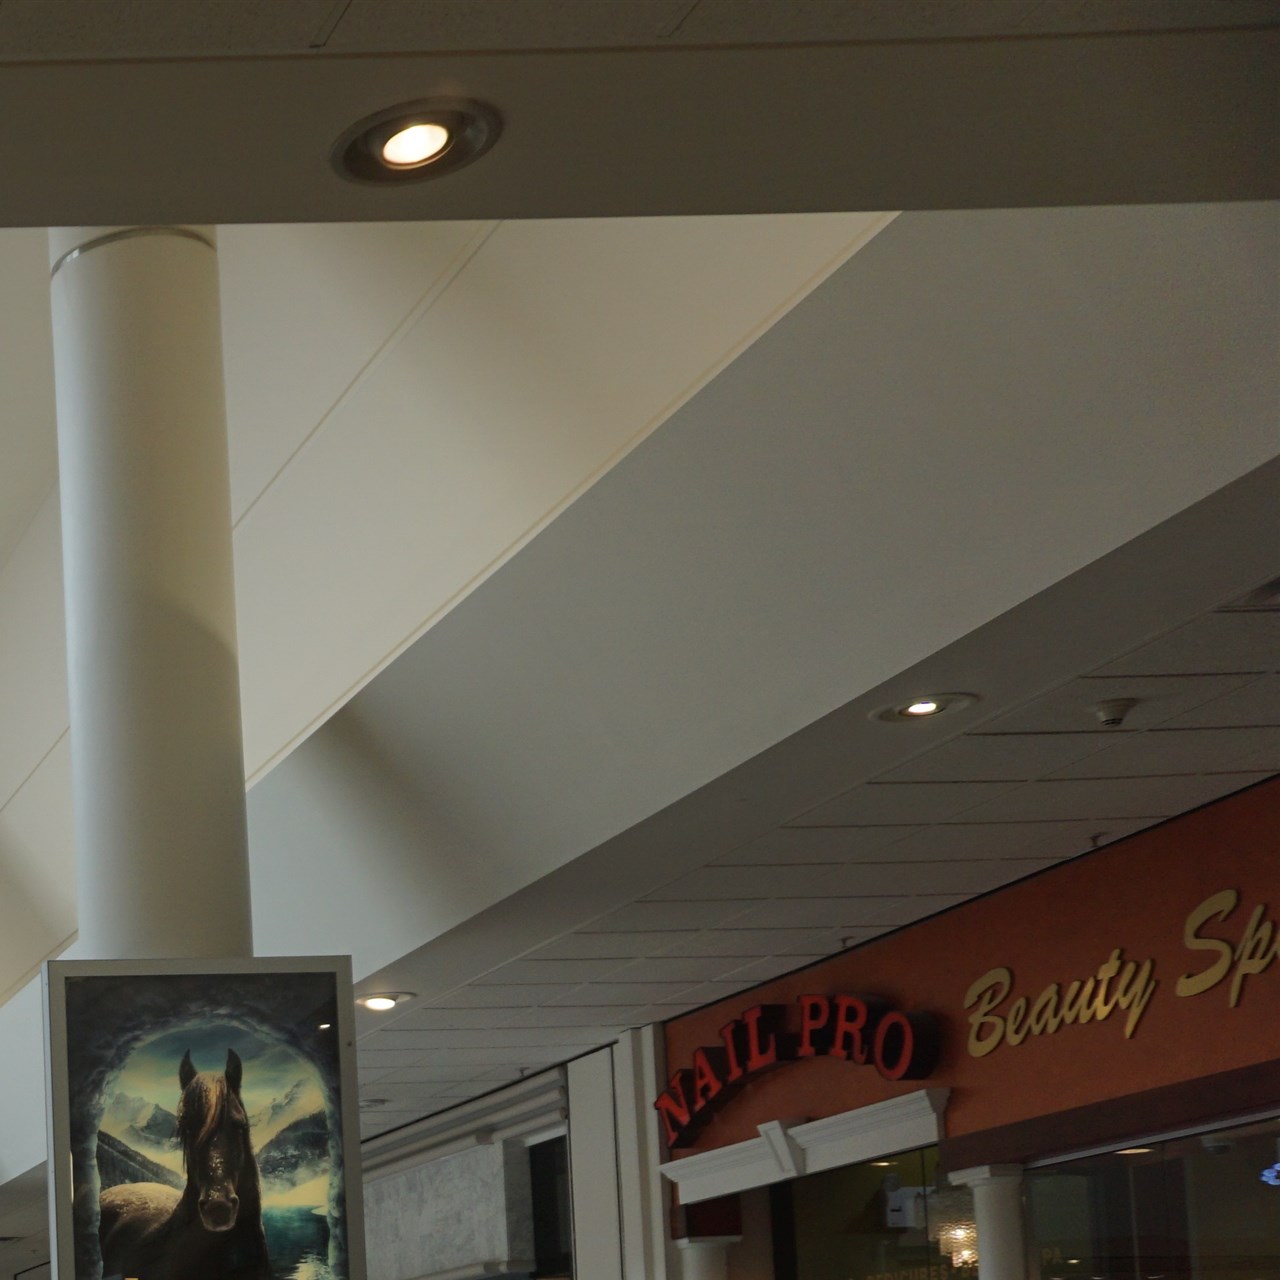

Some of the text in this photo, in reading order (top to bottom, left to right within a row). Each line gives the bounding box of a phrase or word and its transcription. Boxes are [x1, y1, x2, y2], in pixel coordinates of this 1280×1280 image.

[963, 889, 1280, 1058] Beauty Sp
[654, 993, 915, 1147] NAIL PRO
